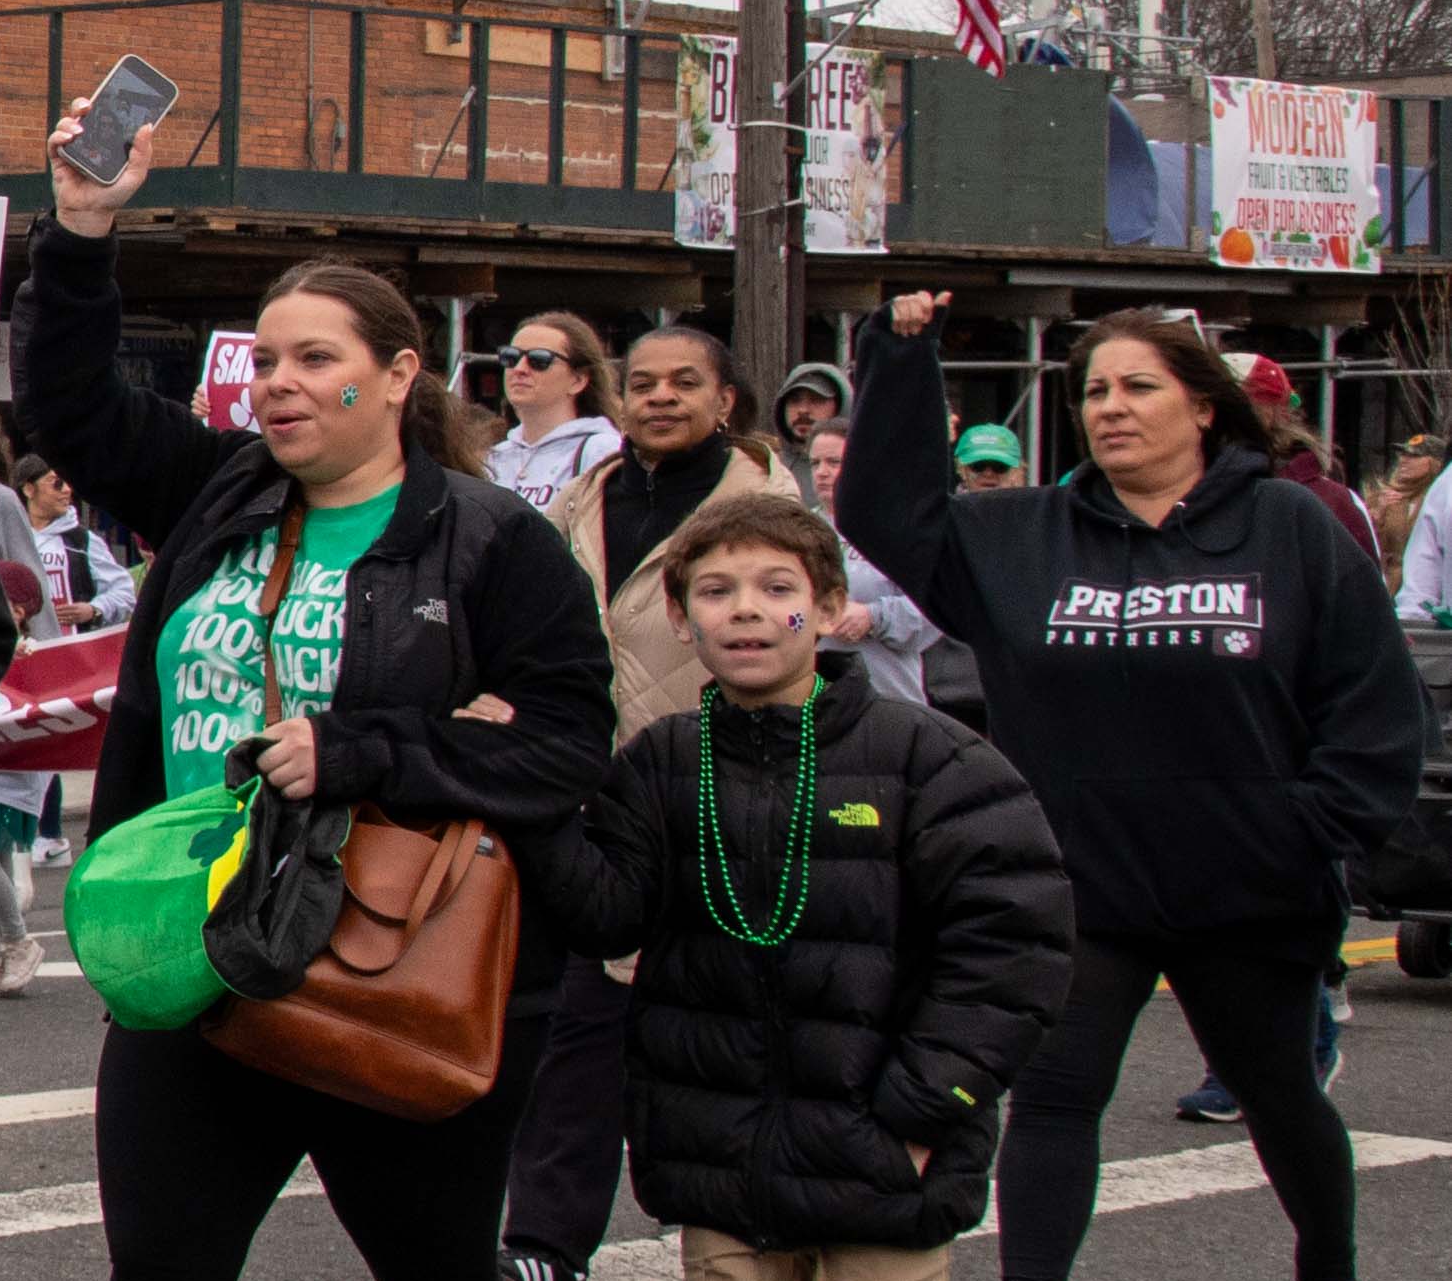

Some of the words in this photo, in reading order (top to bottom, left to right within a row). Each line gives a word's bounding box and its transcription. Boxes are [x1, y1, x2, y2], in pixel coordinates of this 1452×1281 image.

[806, 61, 851, 132] REE
[1246, 91, 1347, 159] MODERN
[1248, 161, 1277, 191] FRUIT
[1237, 197, 1270, 231] OPEN
[1298, 201, 1356, 234] BUSINESS
[1063, 583, 1247, 620] PRESTON
[1045, 629, 1203, 647] PANTHERS
